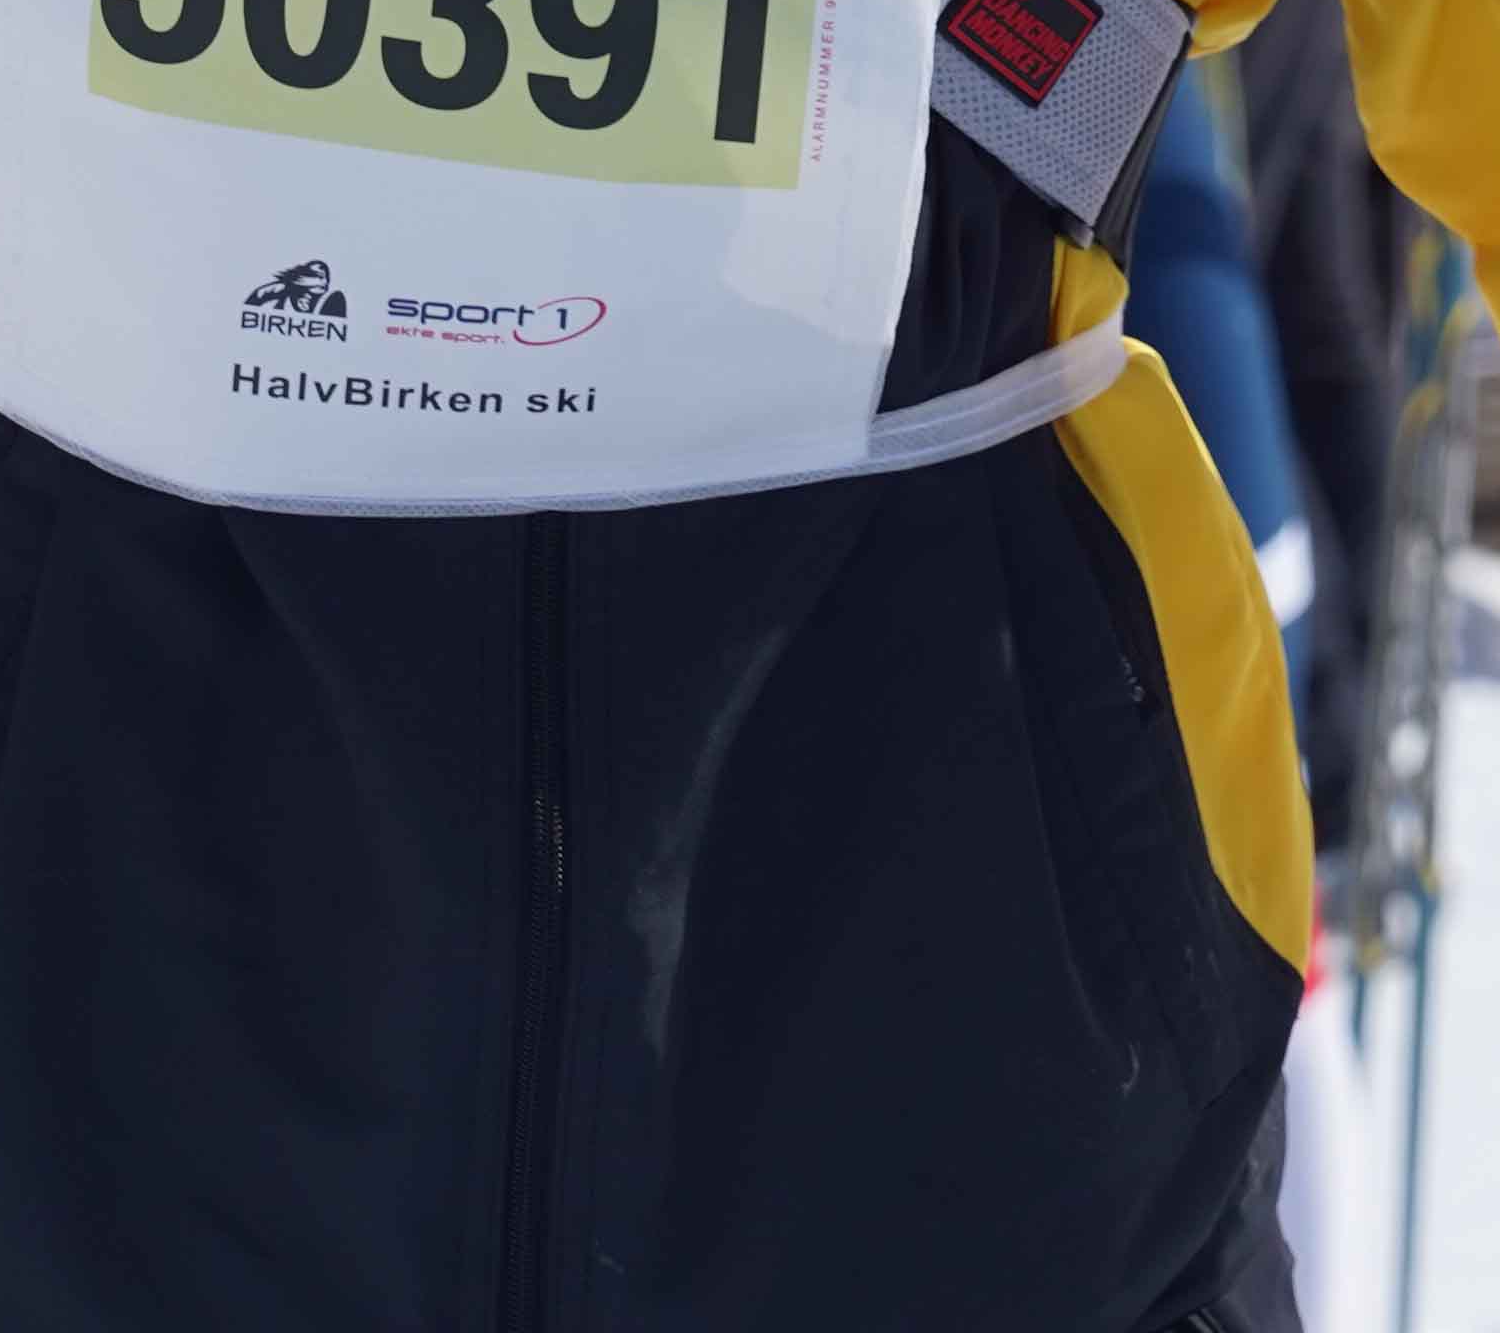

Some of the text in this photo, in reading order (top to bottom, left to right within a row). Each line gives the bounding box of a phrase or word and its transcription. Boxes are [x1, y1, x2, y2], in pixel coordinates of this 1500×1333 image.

[963, 9, 1058, 81] MONKEY
[240, 310, 347, 342] BIRKEN
[387, 298, 535, 326] sport
[232, 363, 597, 414] HalvBirken ski
